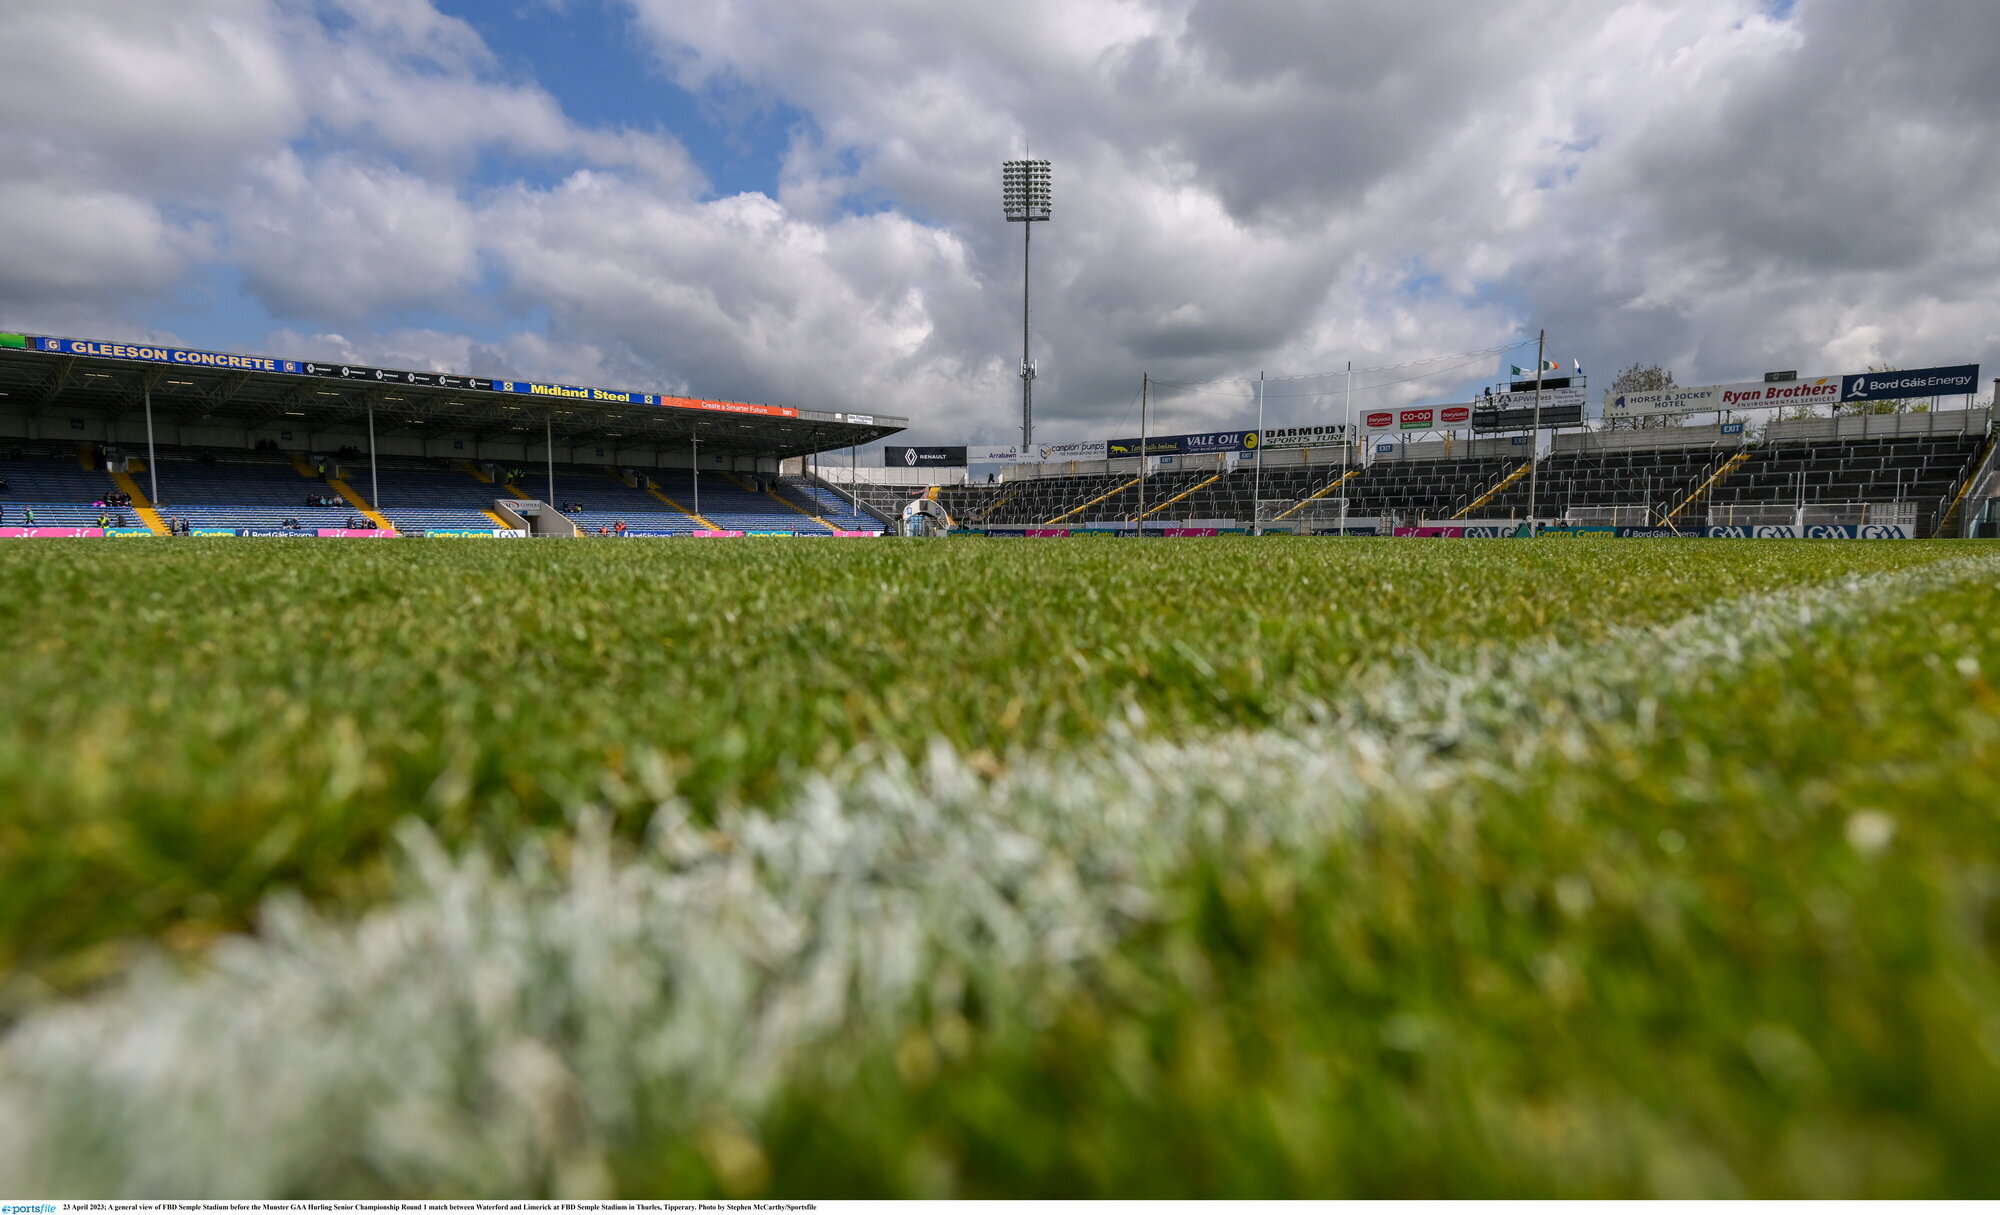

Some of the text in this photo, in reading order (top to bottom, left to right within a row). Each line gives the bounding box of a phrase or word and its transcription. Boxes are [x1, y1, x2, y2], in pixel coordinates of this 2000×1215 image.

[71, 341, 275, 370] GLEESON CONCRETE
[1870, 375, 1972, 390] Bord Gáis Energy
[531, 384, 629, 402] Midland Steel
[1630, 395, 1660, 403] HORSE
[1675, 391, 1712, 400] JOCKEY
[1722, 384, 1838, 405] Ryan Brothers
[701, 401, 720, 409] Create
[726, 403, 748, 412] Smarter
[1654, 400, 1685, 408] HOTEL
[1737, 396, 1835, 408] ENVIRONMENTAL SERVICES
[1265, 425, 1346, 438] DARMODY
[1723, 425, 1740, 433] EXIT
[1187, 434, 1240, 446] VALE OIL
[1266, 434, 1345, 445] SPORTS TURF
[1051, 443, 1105, 452] campion pumps
[1379, 444, 1391, 452] EXIT
[988, 452, 1017, 460] Arrabawn
[1537, 530, 1573, 538] Centra
[1576, 530, 1615, 538] Centra
[1632, 530, 1651, 538] Bord
